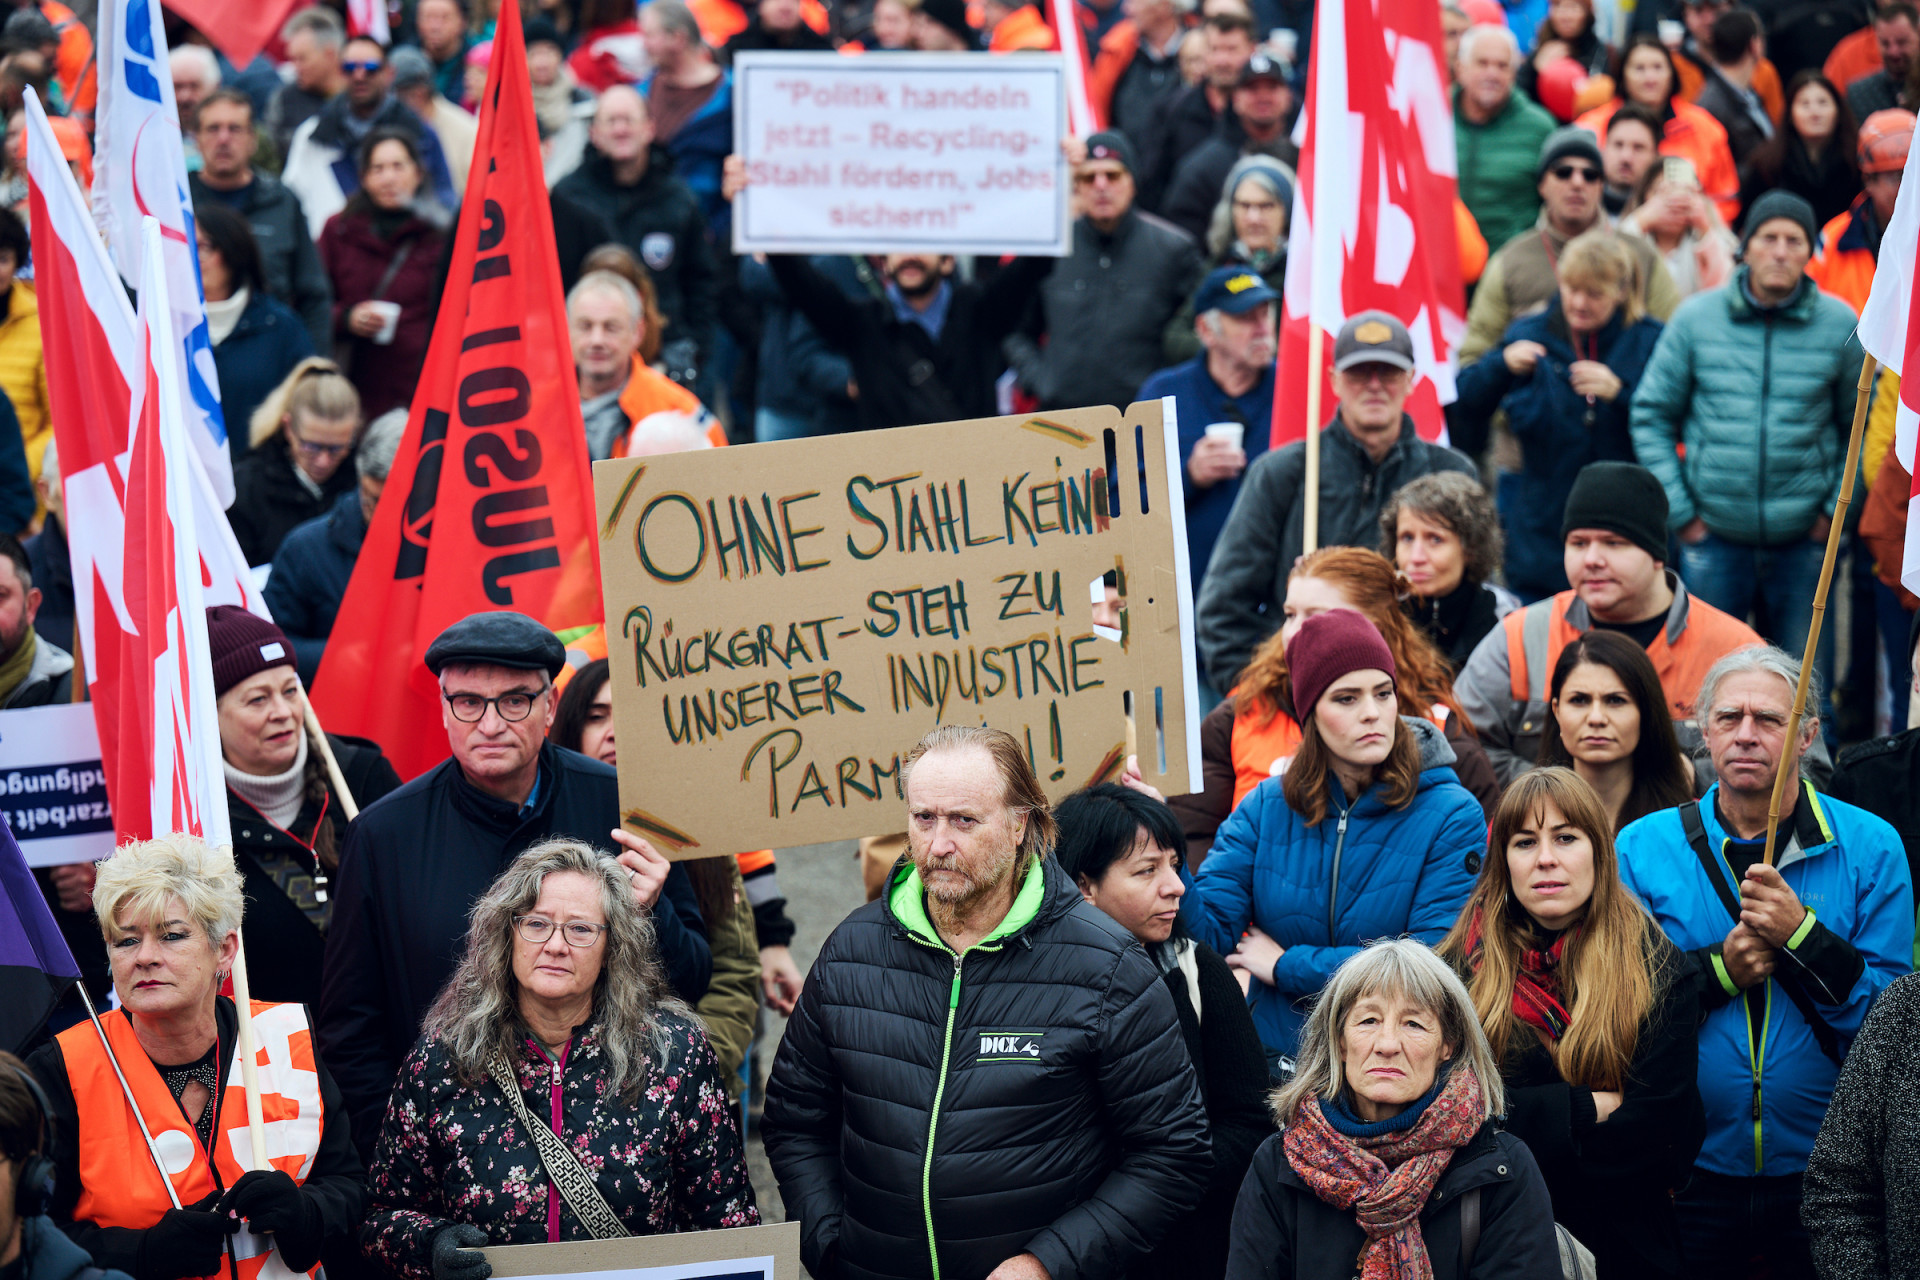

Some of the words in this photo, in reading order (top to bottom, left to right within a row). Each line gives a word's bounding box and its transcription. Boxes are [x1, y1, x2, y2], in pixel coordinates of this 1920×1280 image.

[775, 80, 890, 109] "Politik
[901, 84, 1031, 110] handeln
[764, 121, 831, 151] jetzt
[869, 122, 1041, 155] Recycling-
[749, 160, 830, 188] Stahl
[840, 163, 967, 192] fördern,
[975, 165, 1054, 190] Jobs
[633, 490, 832, 583] OHNE
[845, 470, 1006, 561] STAHL
[992, 568, 1065, 622] ZU
[663, 668, 867, 747] UNSERER
[886, 626, 1106, 726] INDUSTRIE
[980, 1036, 1020, 1055] DICK
